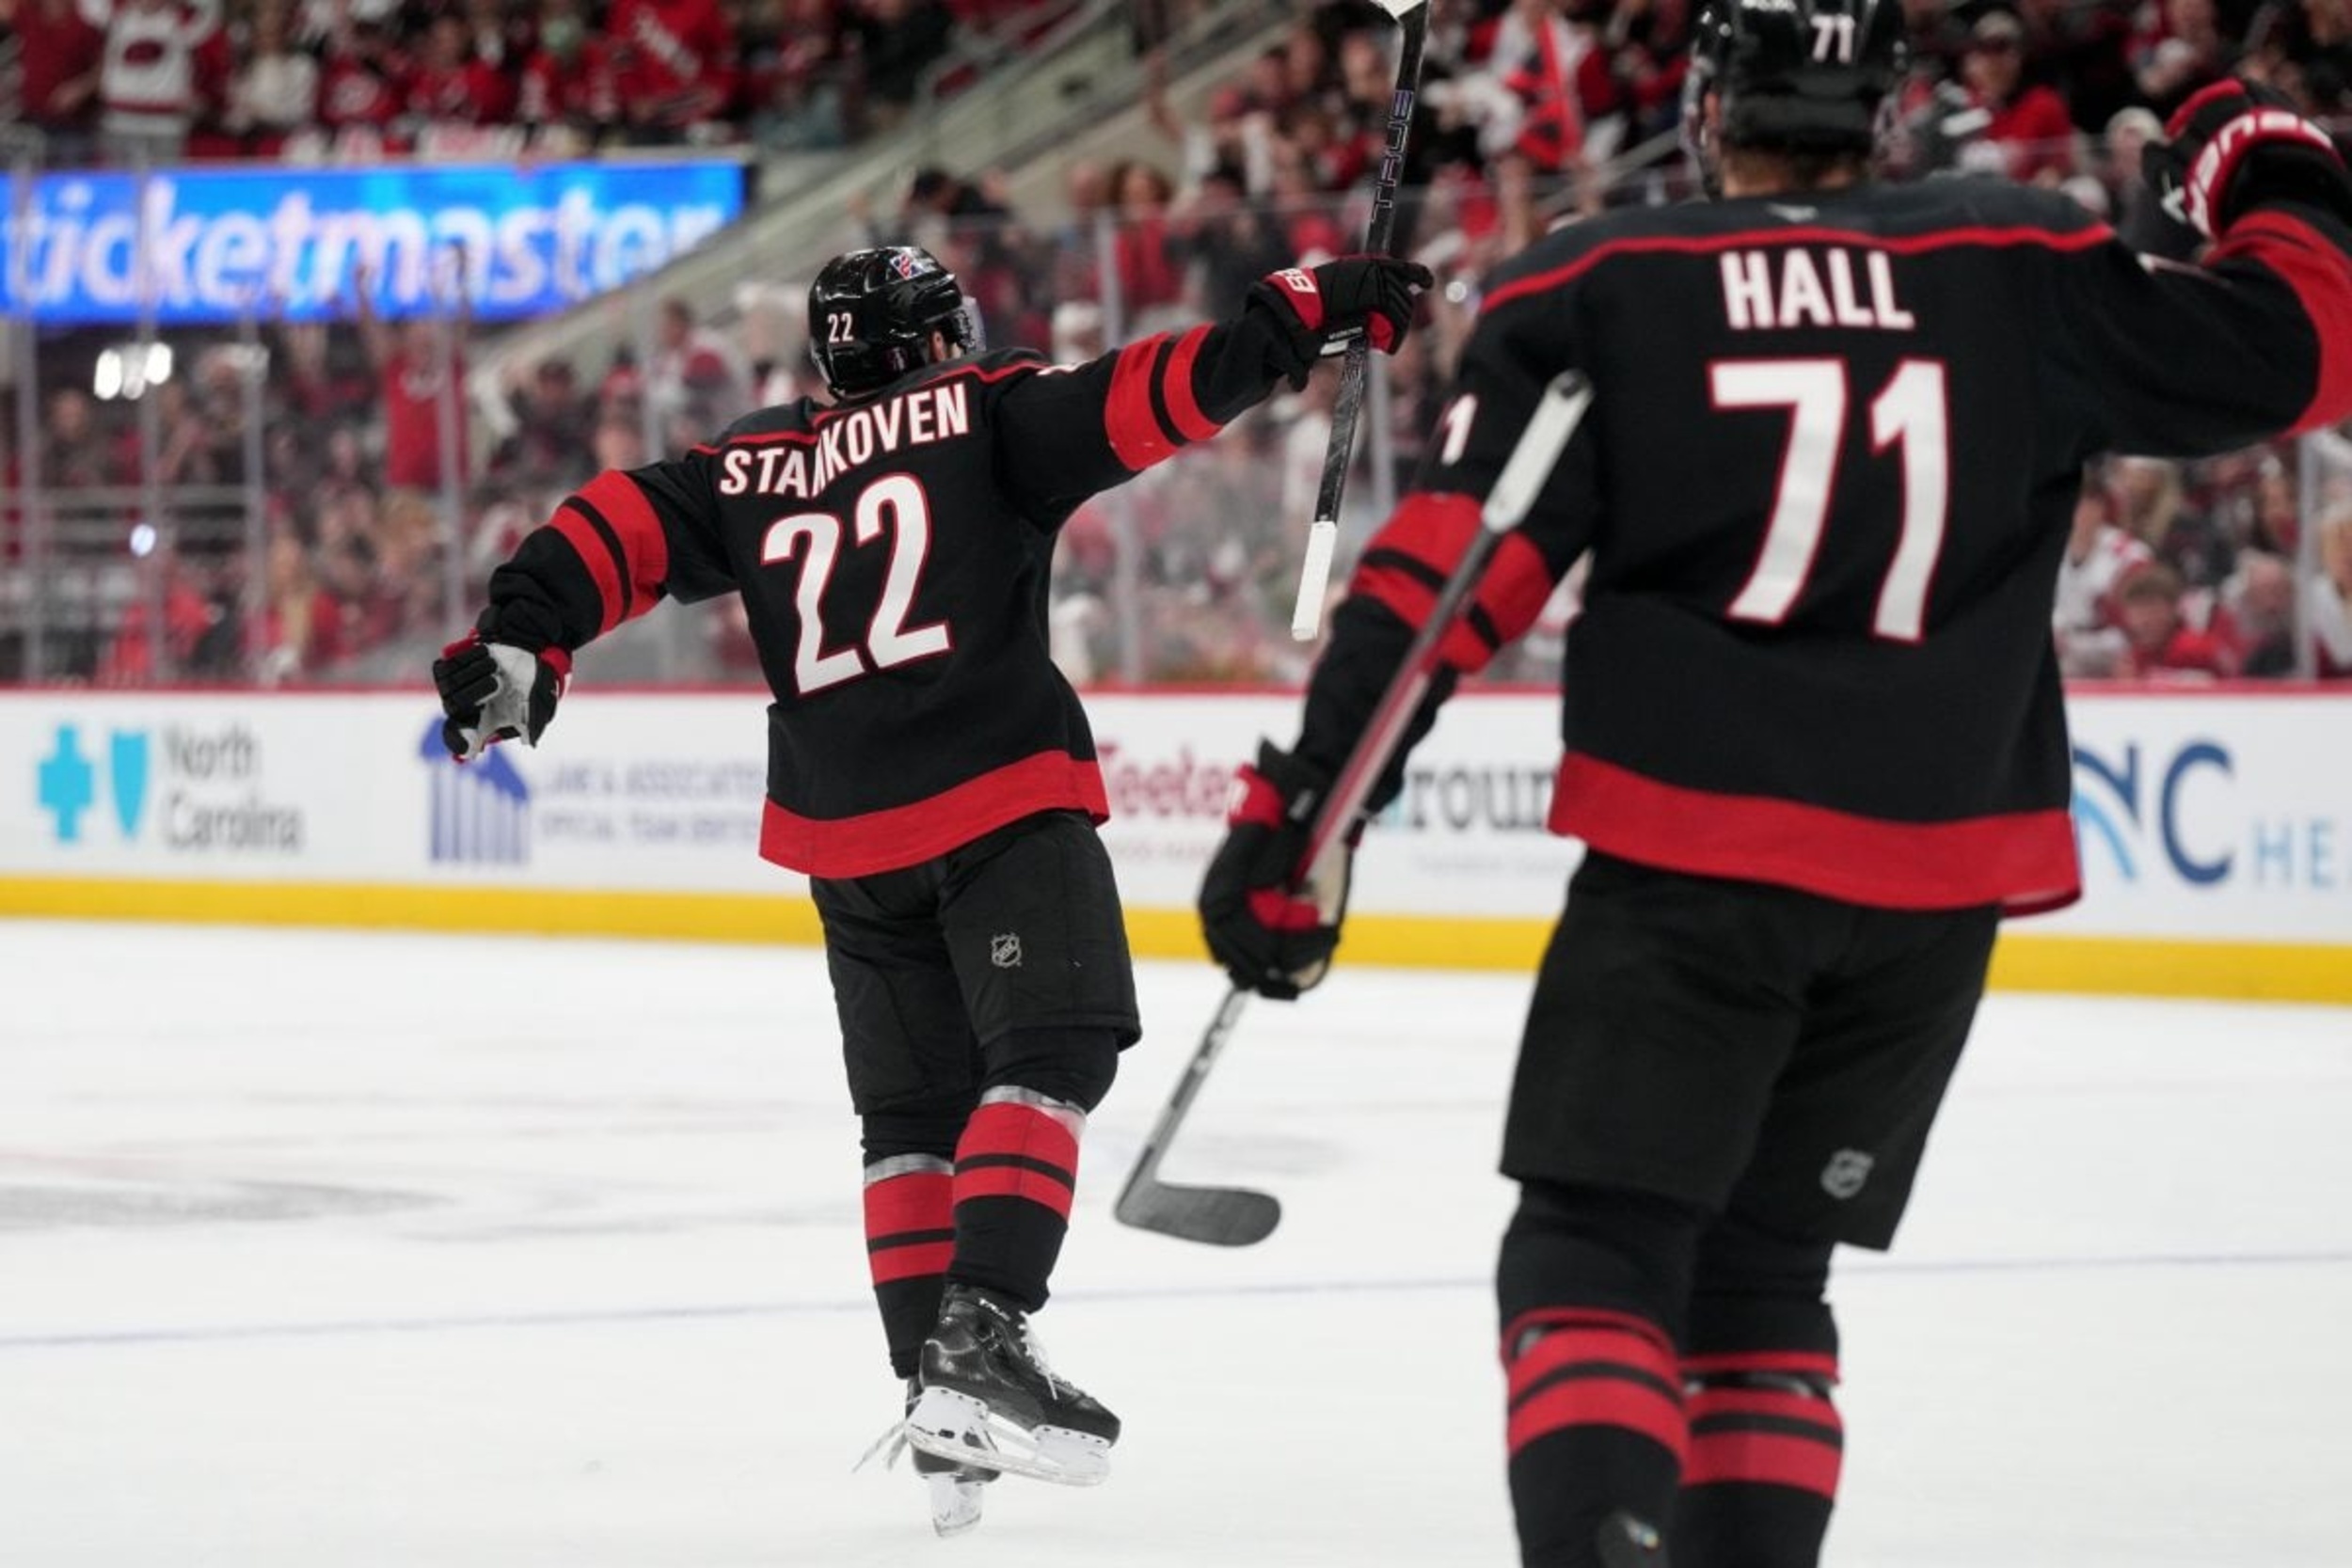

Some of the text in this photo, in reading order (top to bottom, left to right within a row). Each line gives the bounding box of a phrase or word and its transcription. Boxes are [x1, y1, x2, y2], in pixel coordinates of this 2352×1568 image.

[1810, 13, 1855, 63] 71
[1371, 89, 1414, 224] TRUE
[8, 175, 724, 307] ticketmaster
[827, 312, 854, 343] 22
[1720, 246, 1915, 330] HALL
[1707, 355, 1951, 643] 71
[760, 472, 952, 697] 22
[162, 719, 261, 779] North
[163, 792, 305, 853] Carolina
